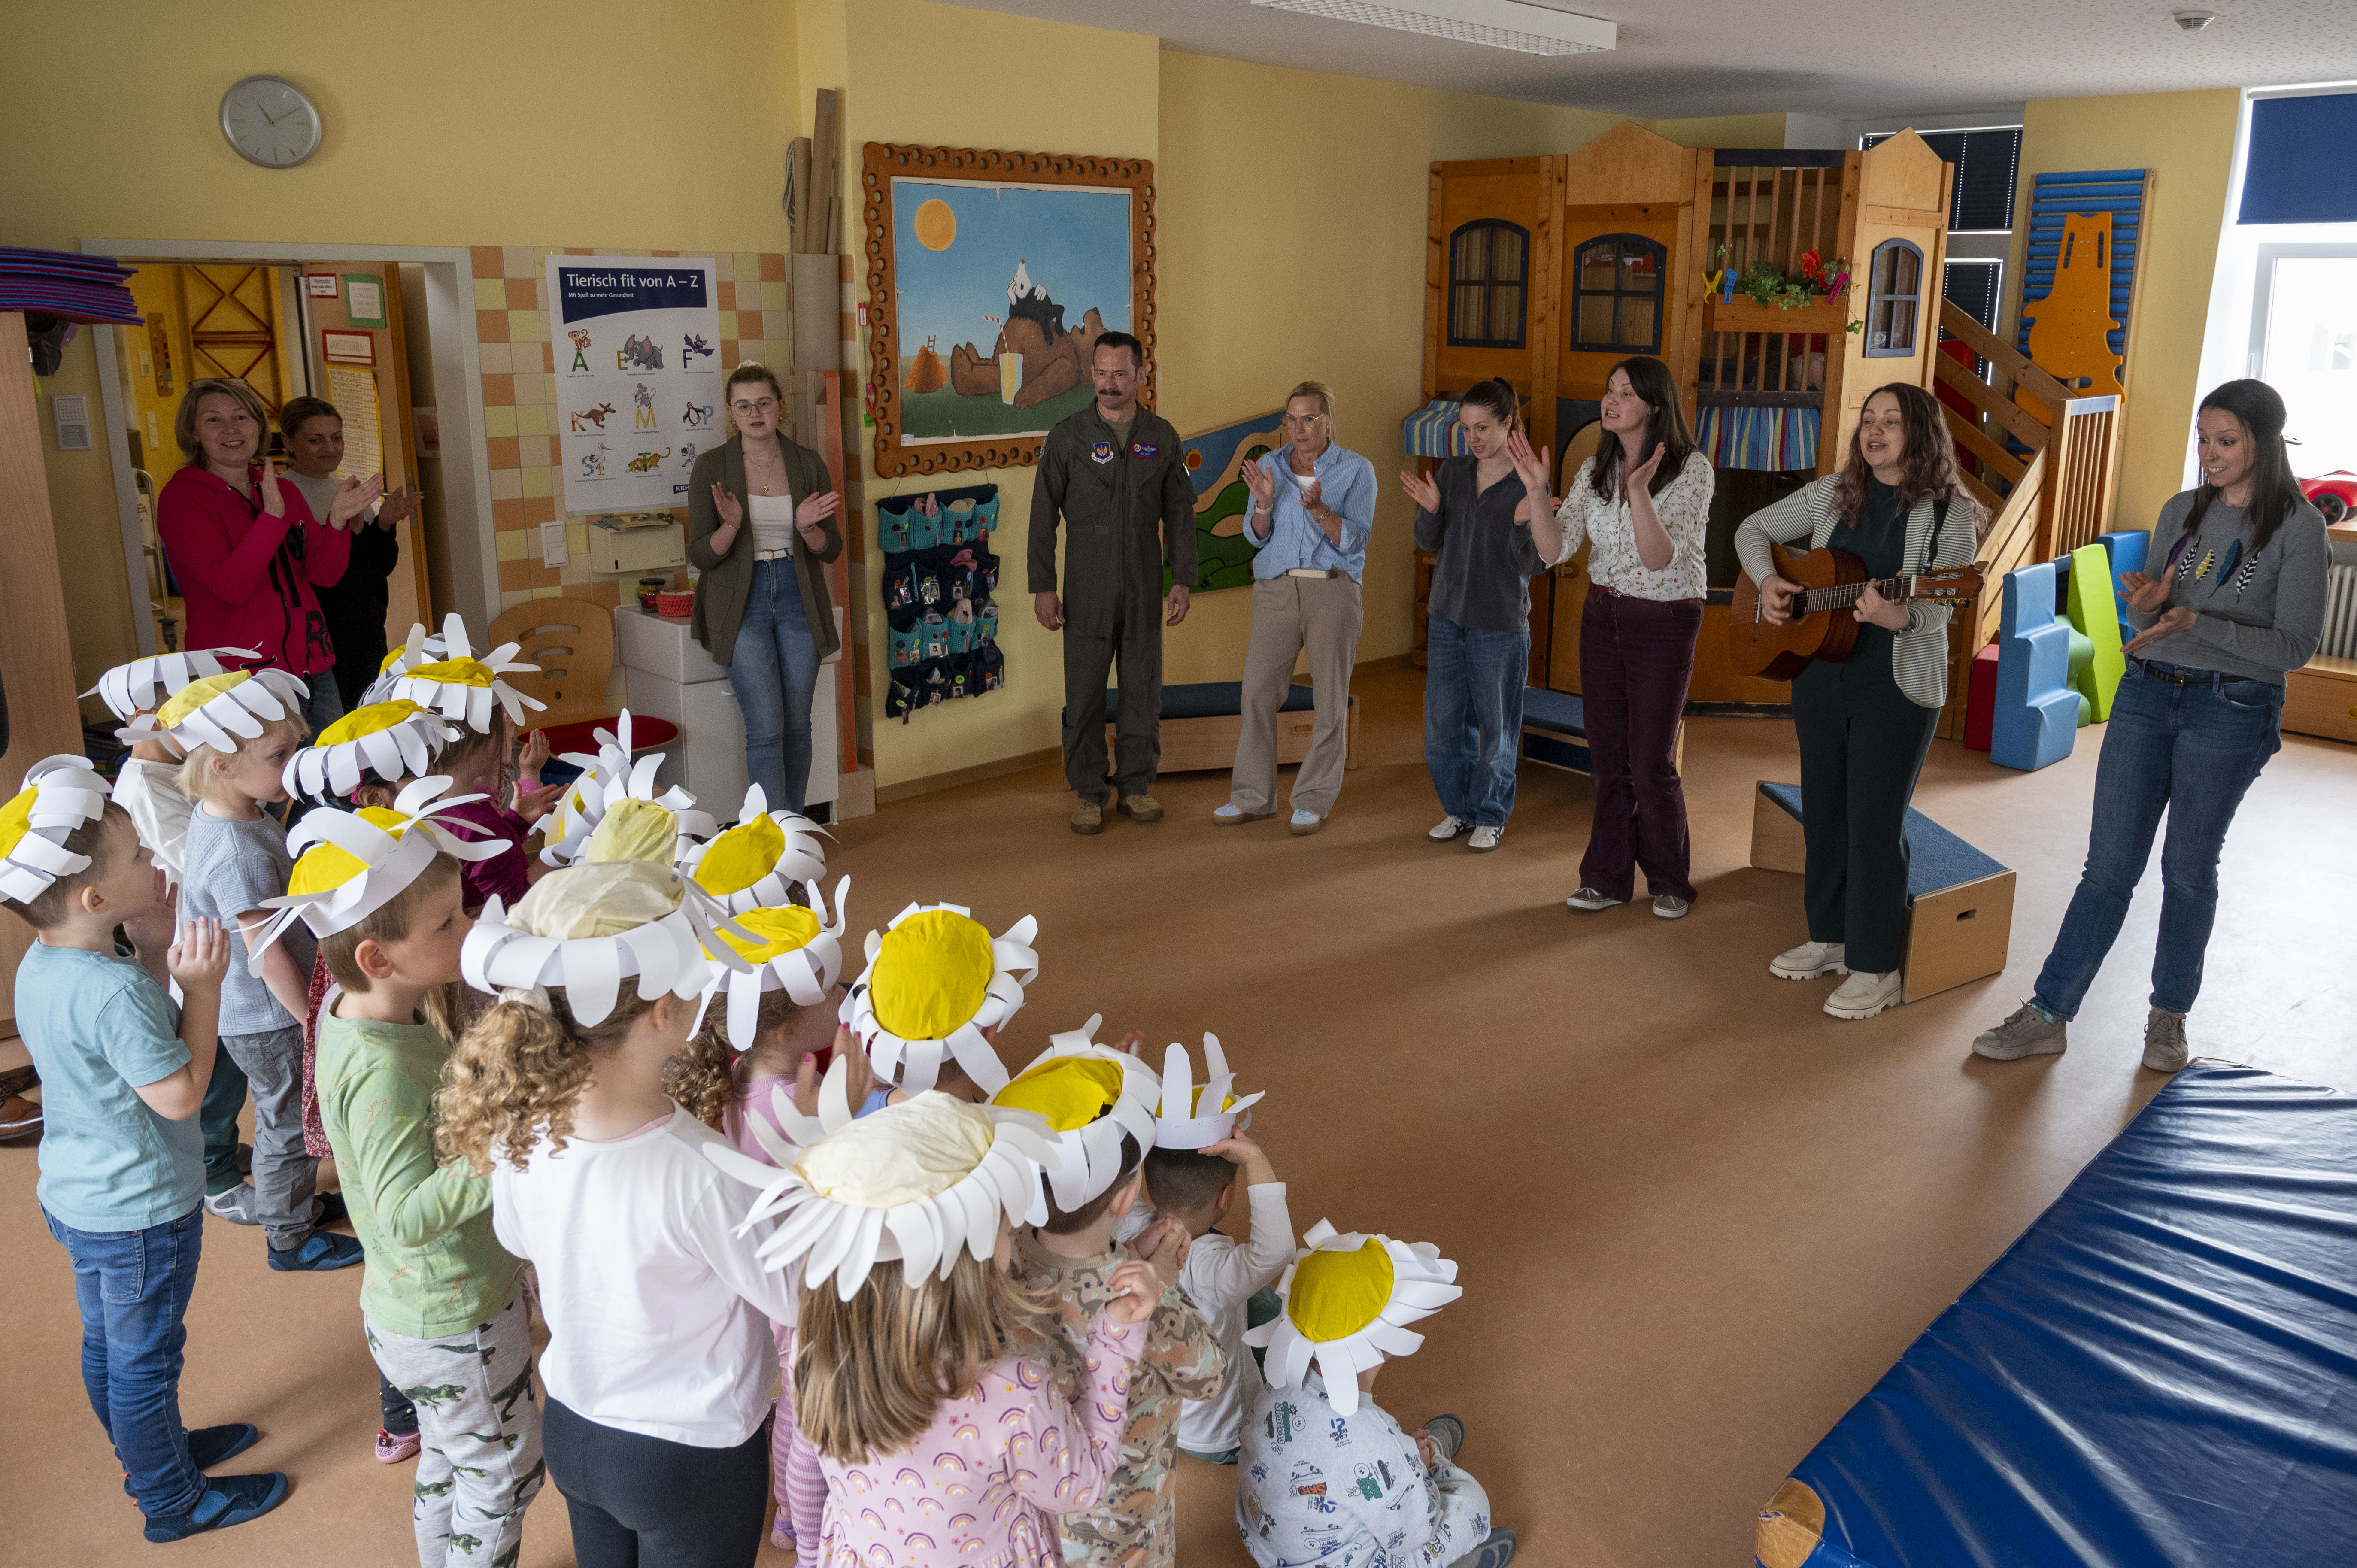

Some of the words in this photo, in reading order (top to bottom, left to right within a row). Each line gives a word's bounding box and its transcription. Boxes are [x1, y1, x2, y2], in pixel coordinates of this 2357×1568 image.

[567, 273, 616, 287] Tierisch
[620, 273, 636, 287] fit
[639, 277, 662, 287] von
[667, 275, 676, 287] A
[690, 276, 698, 287] Z
[572, 351, 589, 372] A
[683, 349, 692, 369] F
[636, 408, 657, 428] M
[703, 406, 714, 425] P
[1275, 1402, 1285, 1444] Skaters
